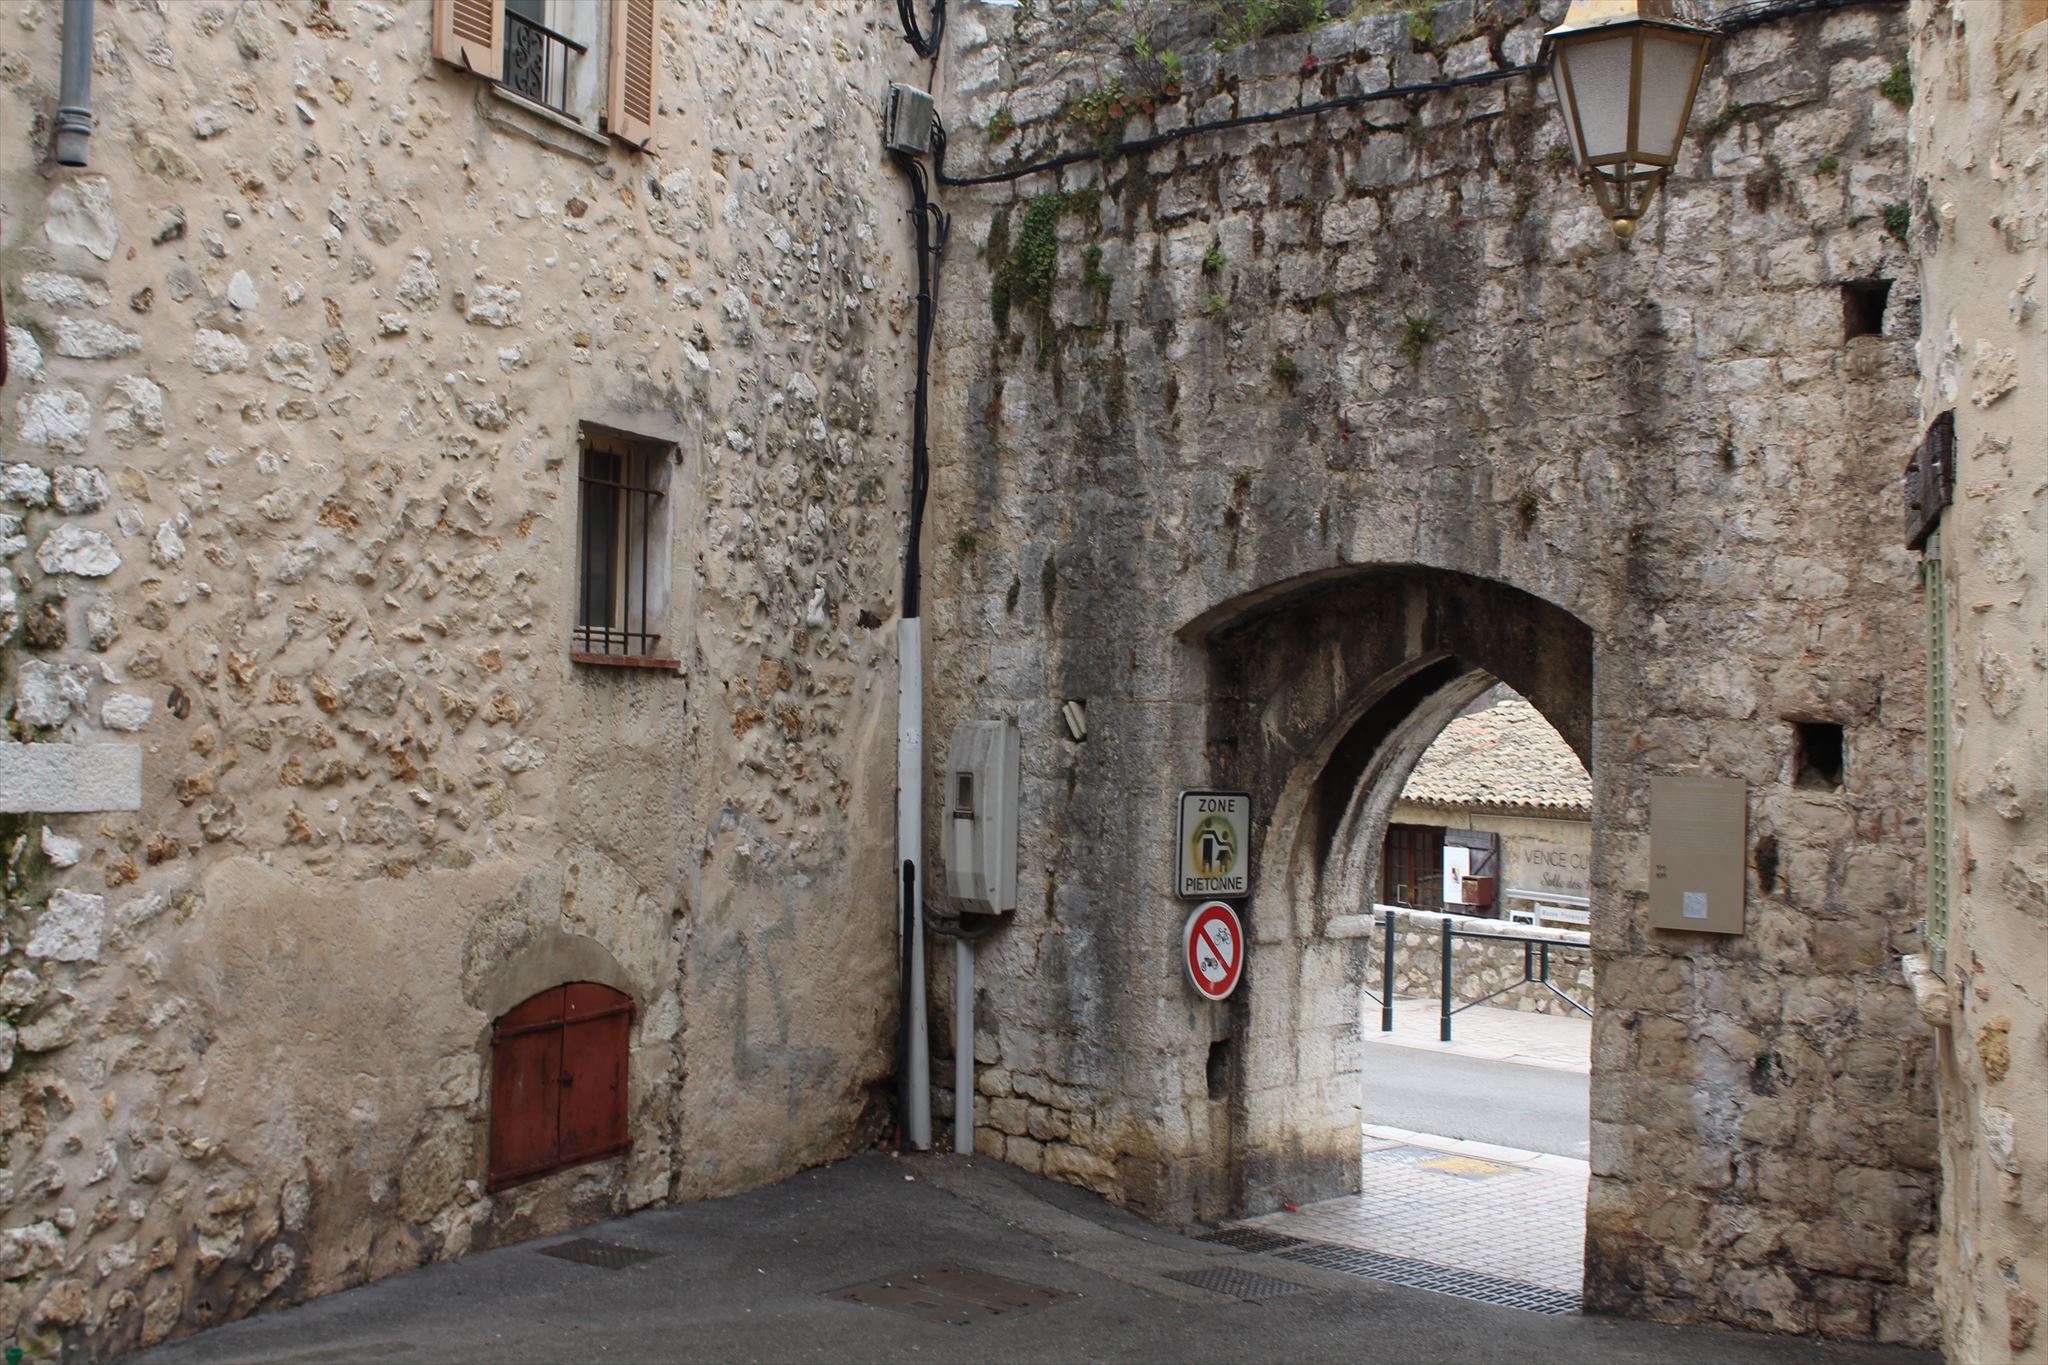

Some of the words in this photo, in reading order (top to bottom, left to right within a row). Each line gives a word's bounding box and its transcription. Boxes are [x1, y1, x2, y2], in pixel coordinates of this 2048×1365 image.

[1198, 798, 1235, 813] ZONE
[1524, 849, 1567, 868] VENCE
[1185, 877, 1243, 891] PIETONNE
